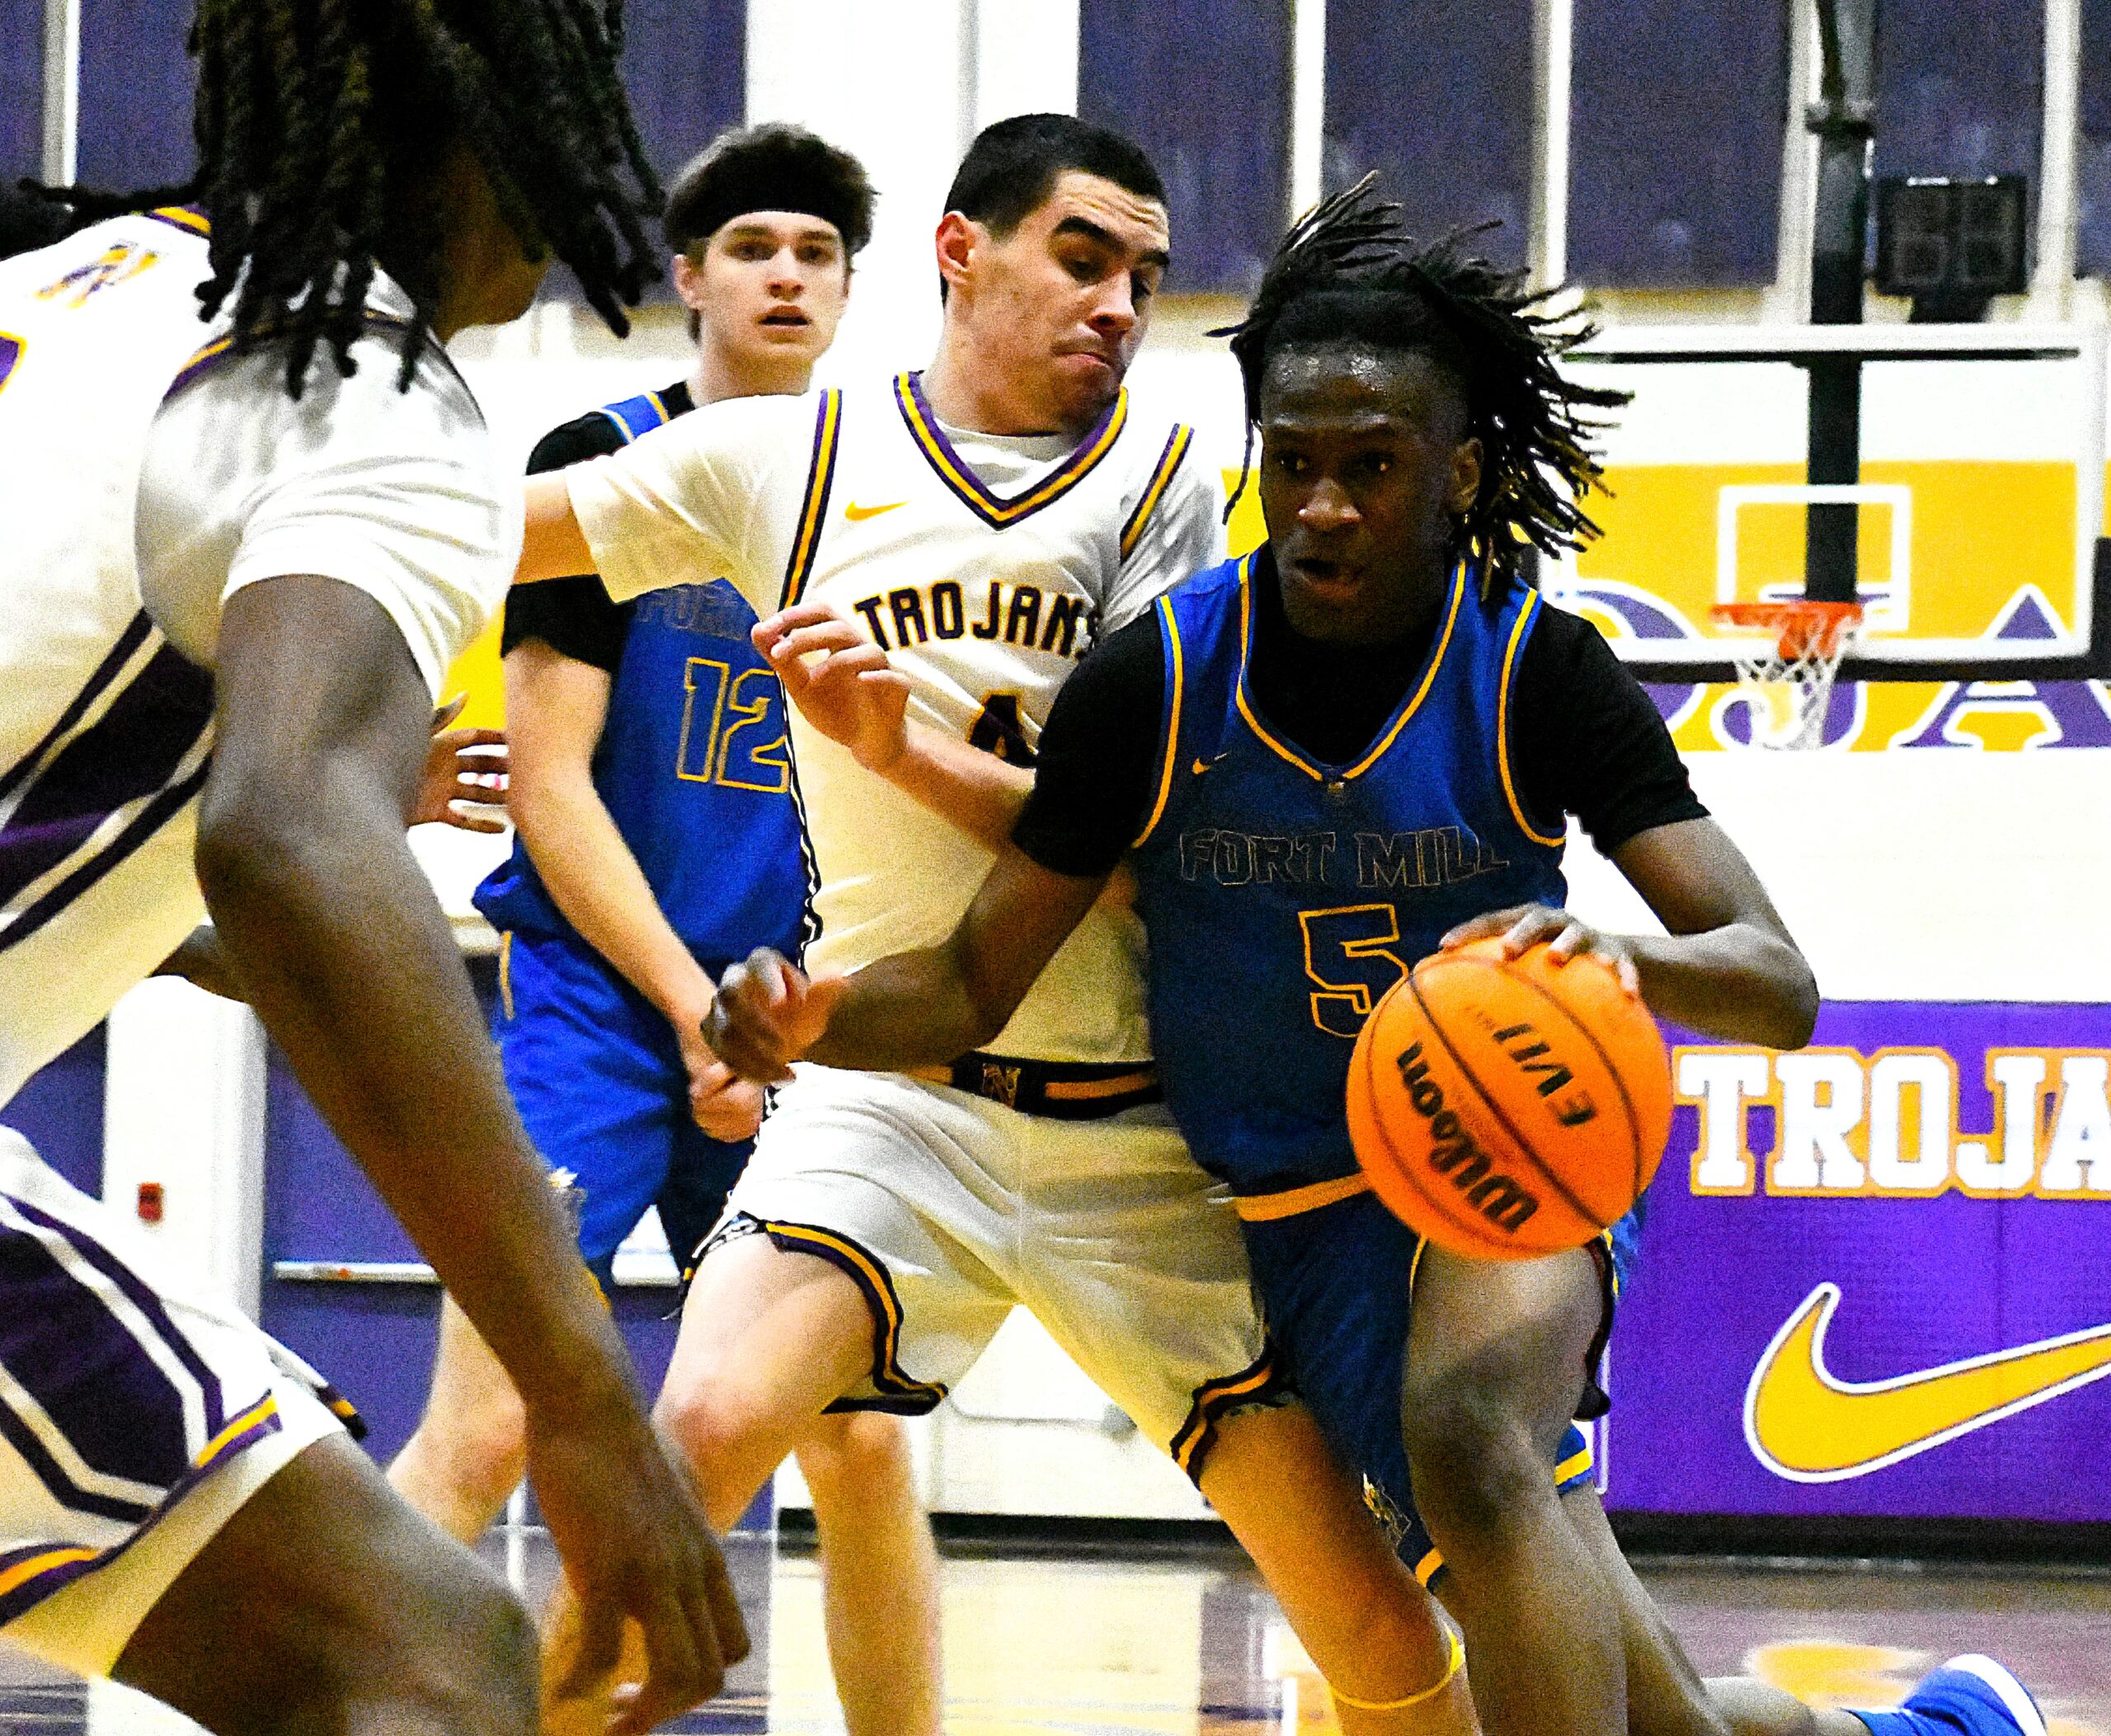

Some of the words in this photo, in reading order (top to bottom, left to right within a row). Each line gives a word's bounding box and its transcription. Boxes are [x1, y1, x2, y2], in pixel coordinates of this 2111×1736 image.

[676, 656, 791, 793] 12
[1179, 827, 1336, 886] FORT
[1353, 826, 1510, 888] MILL
[1297, 904, 1409, 1038] 5
[1396, 1041, 1540, 1234] Wilson
[1672, 1046, 2111, 1199] TROJA
